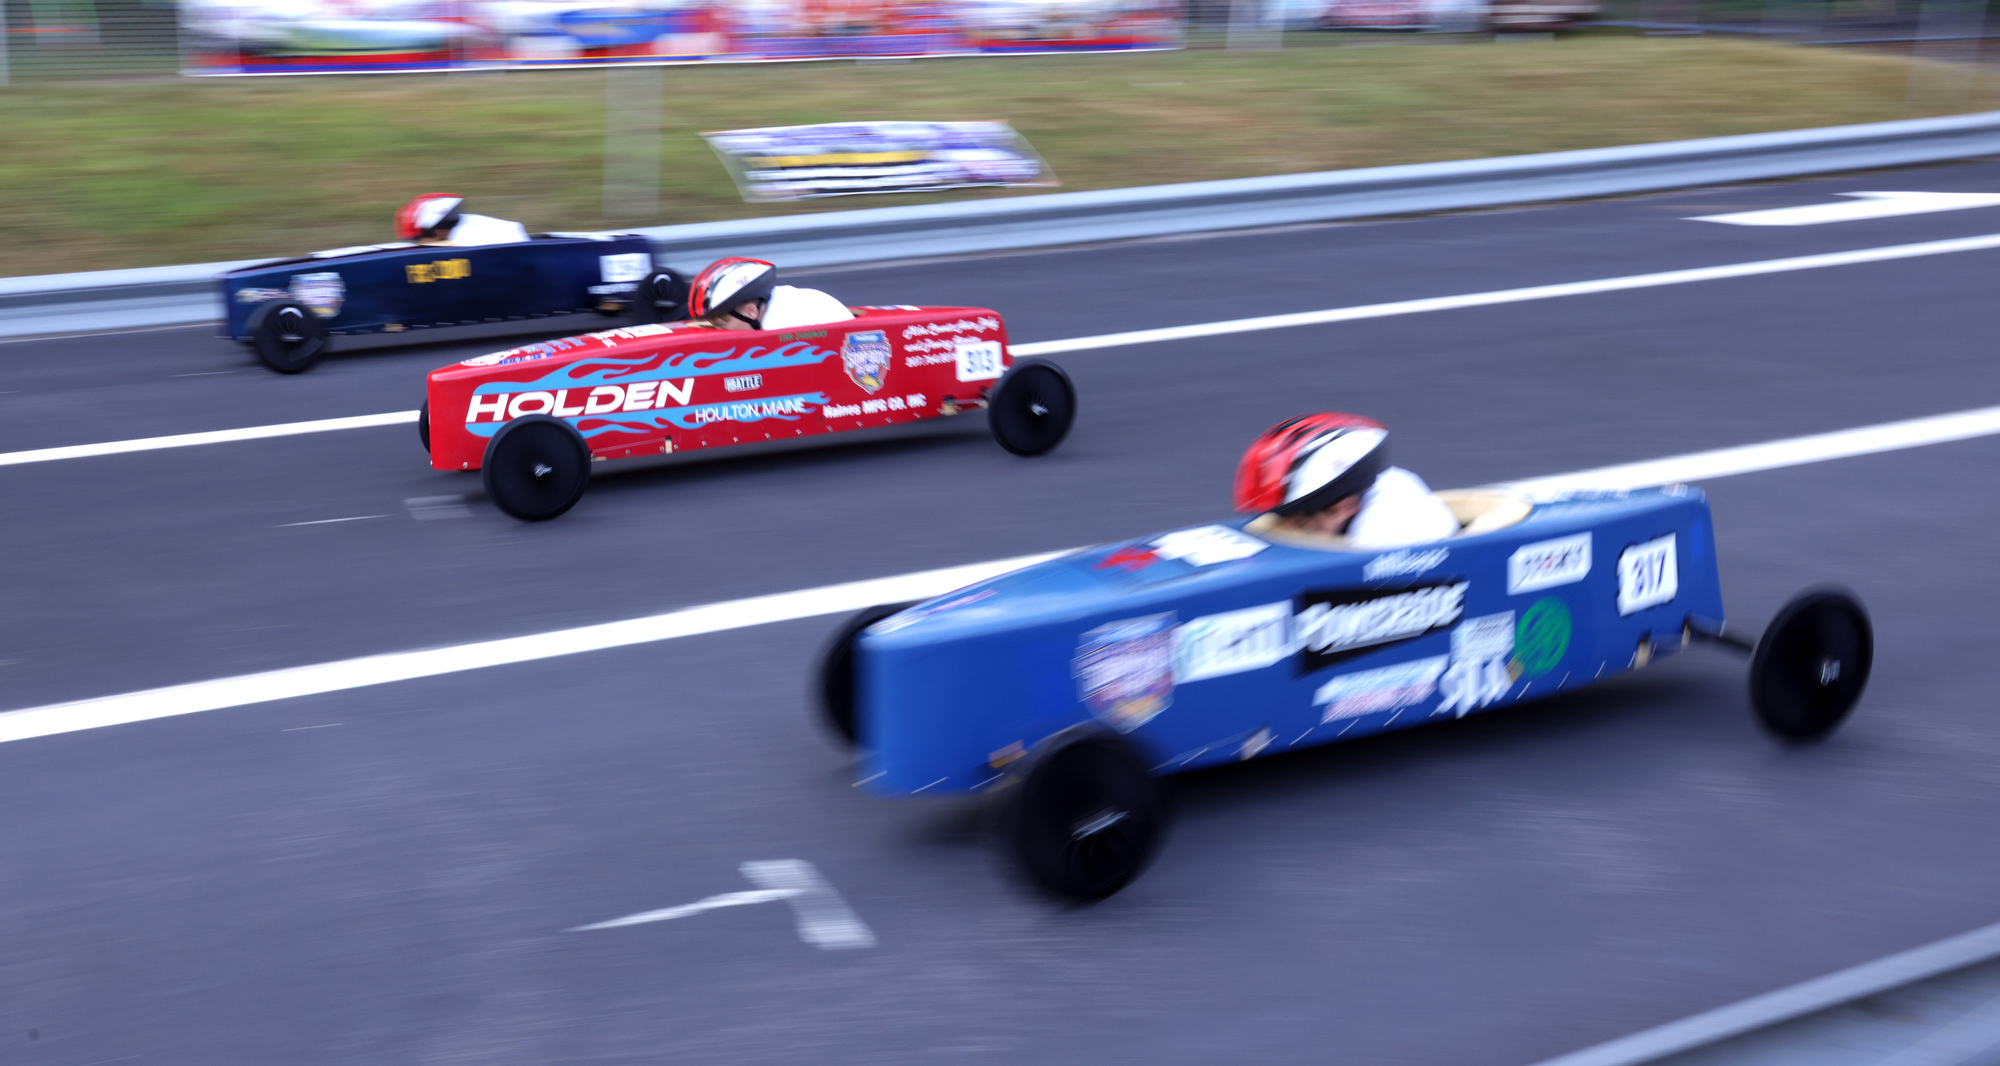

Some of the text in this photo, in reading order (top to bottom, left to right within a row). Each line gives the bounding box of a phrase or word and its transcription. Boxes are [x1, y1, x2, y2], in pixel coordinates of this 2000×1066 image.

[465, 377, 695, 423] HOLDEN
[763, 397, 806, 416] MAINE
[1631, 547, 1668, 597] 317
